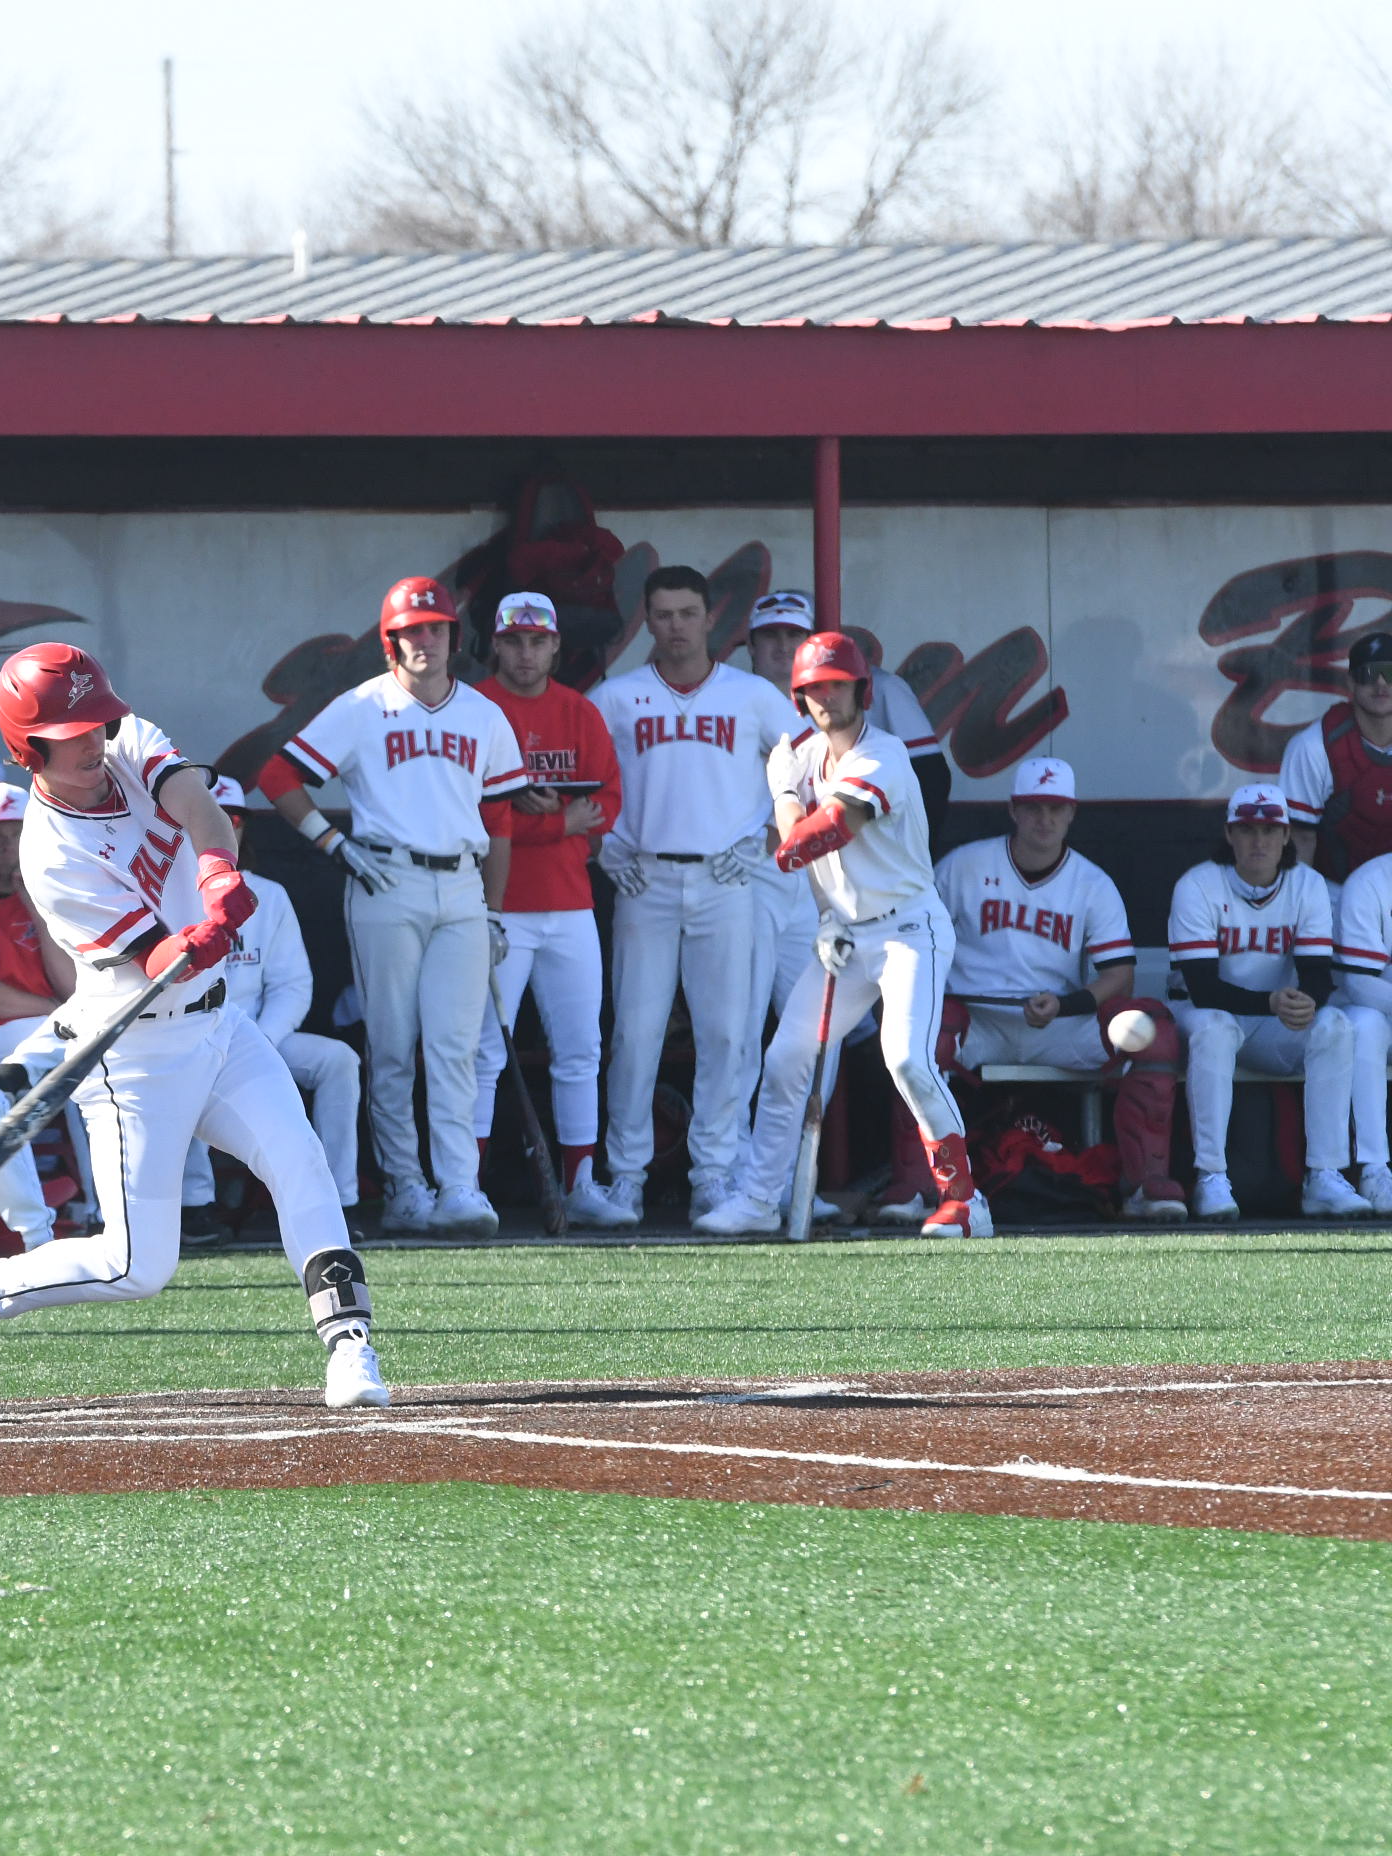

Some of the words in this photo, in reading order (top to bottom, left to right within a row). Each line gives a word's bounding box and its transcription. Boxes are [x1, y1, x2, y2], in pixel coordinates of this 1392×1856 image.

[384, 728, 478, 776] ALLEN
[634, 705, 737, 756] ALLEN
[127, 802, 184, 912] ALL
[980, 898, 1074, 953] ALLEN
